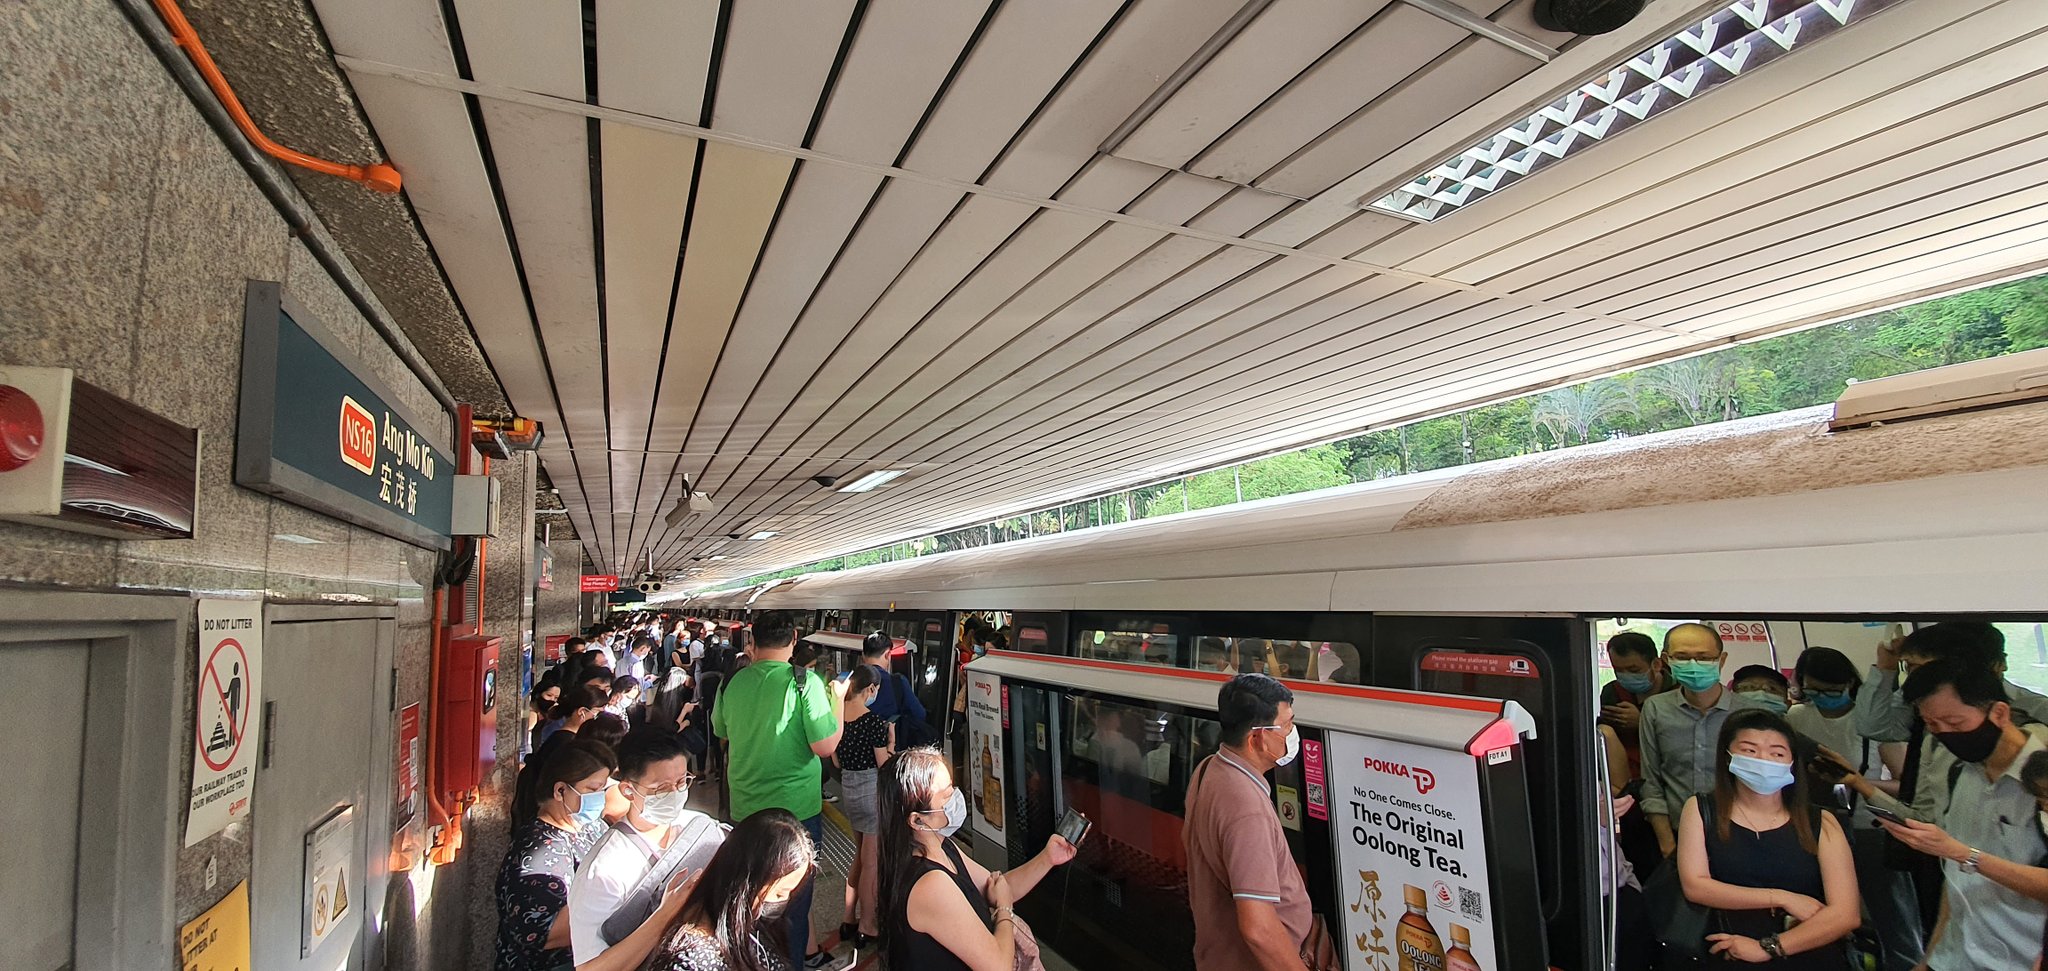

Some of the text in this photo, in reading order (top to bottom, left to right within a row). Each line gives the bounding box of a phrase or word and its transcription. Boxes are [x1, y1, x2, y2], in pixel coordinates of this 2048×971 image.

[345, 414, 372, 458] NS16
[382, 411, 434, 480] Ang Mo Kio
[379, 461, 417, 515] 宏茂桥
[204, 618, 253, 630] DO NOT LITTER
[1364, 757, 1410, 778] POKKA
[1489, 752, 1500, 760] FDT
[192, 766, 248, 797] OUR RAILWAY TRACK IS
[193, 780, 245, 810] OUR WORKPLACE TOO
[1354, 786, 1456, 821] No One Comes Close.
[1350, 801, 1464, 850] The Original
[1352, 826, 1468, 879] Oolong Tea.
[195, 917, 210, 939] NOT
[210, 928, 218, 945] AT
[1401, 940, 1442, 968] OOLONG
